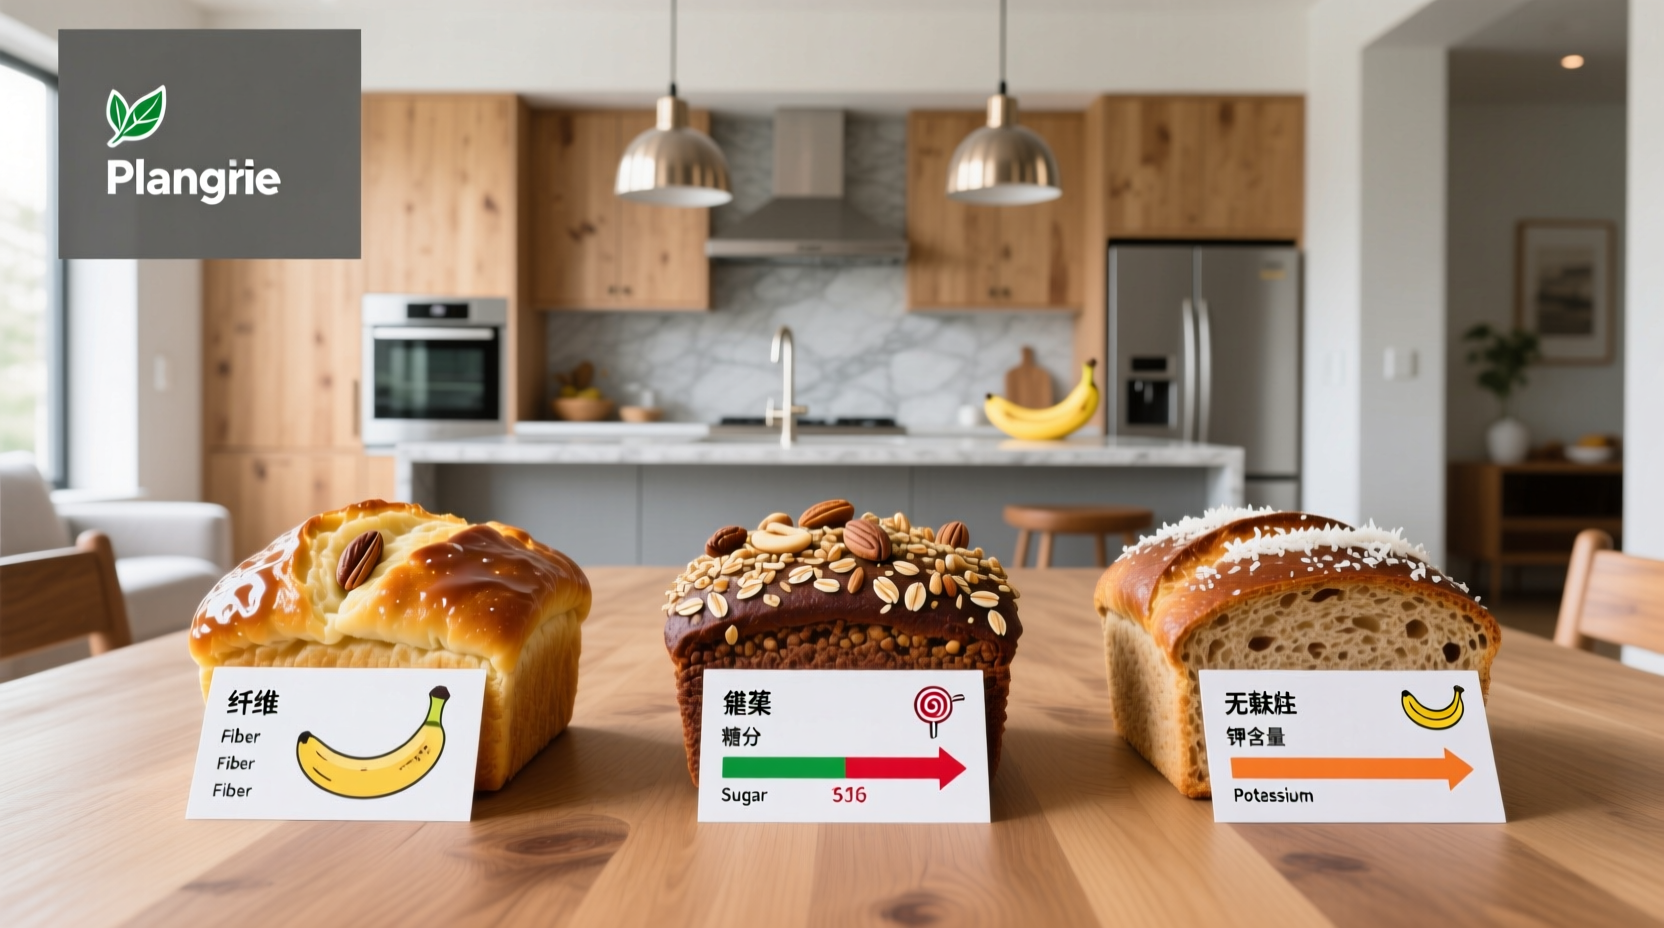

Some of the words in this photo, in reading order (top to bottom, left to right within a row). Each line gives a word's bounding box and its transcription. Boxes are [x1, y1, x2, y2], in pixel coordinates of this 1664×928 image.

[226, 689, 280, 716] 纤维
[220, 727, 261, 744] Fiber
[216, 755, 256, 770] Fiber
[212, 782, 253, 798] Fiber
[721, 787, 768, 807] Sugar
[1233, 786, 1314, 803] Potassium
